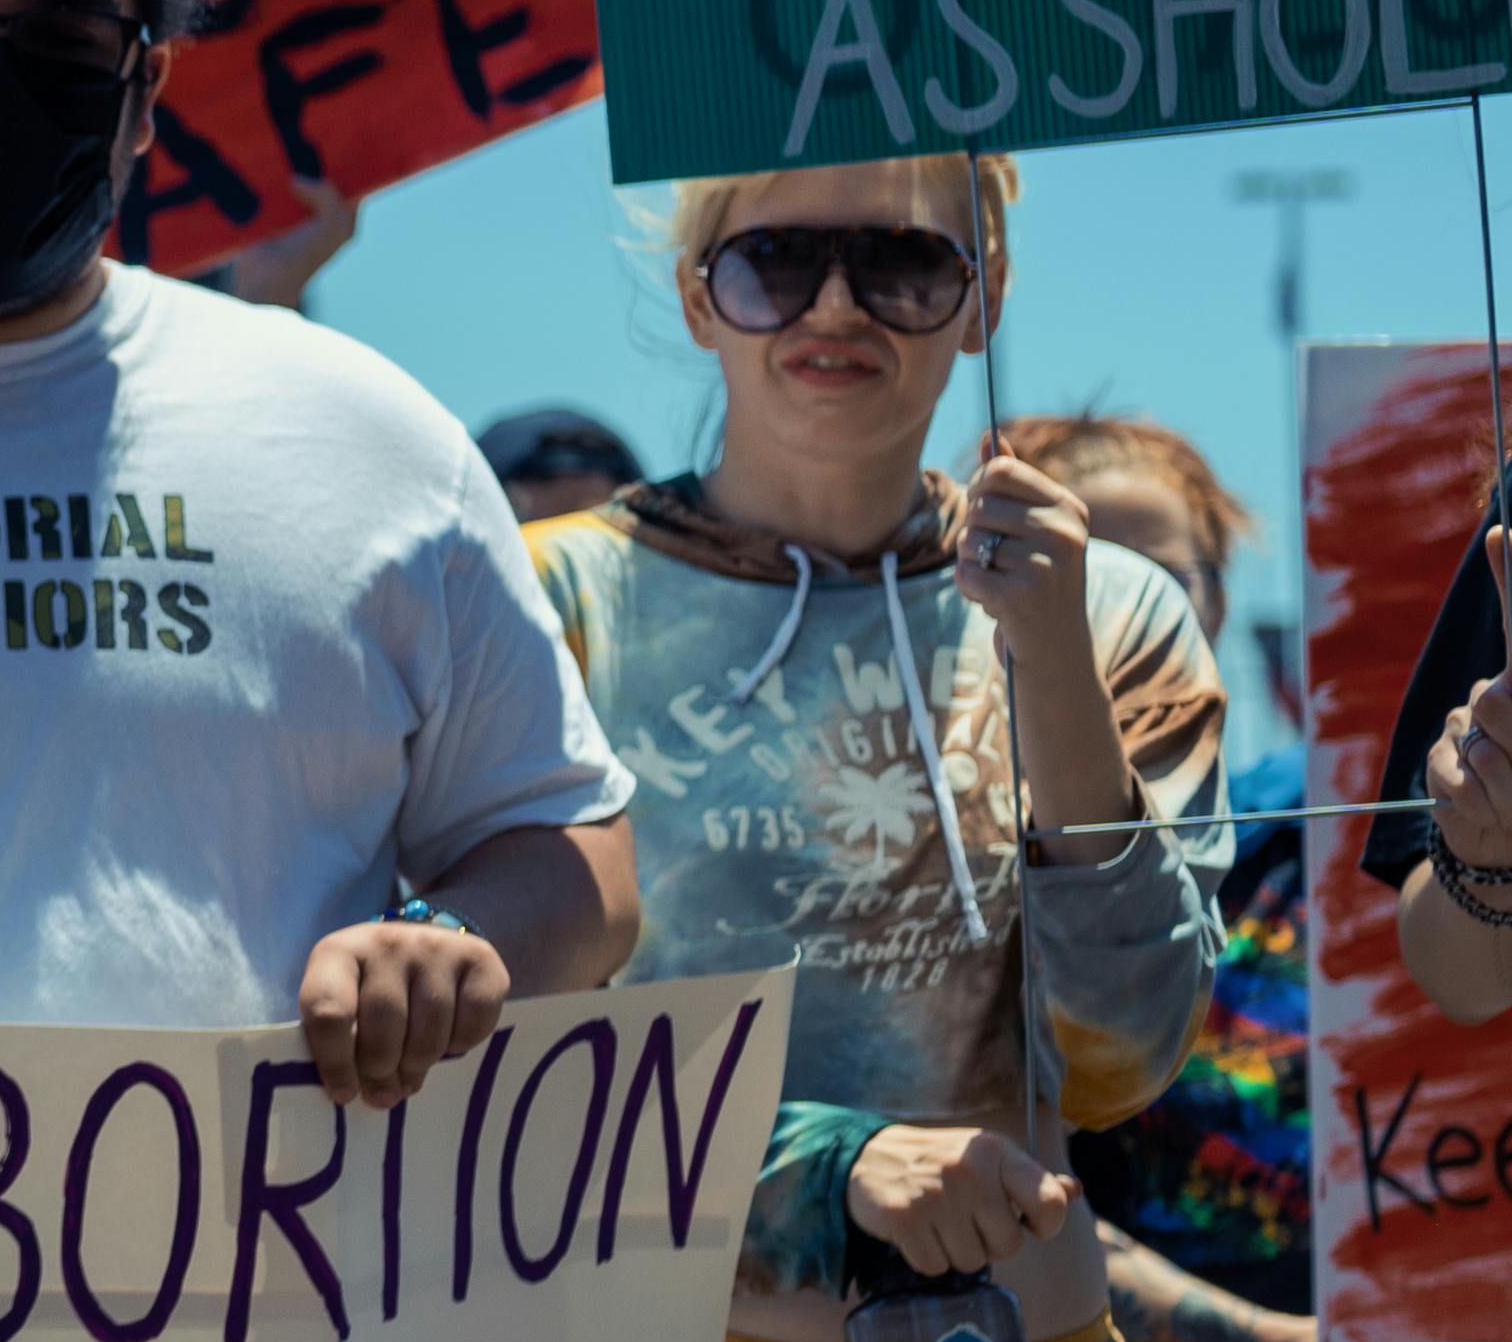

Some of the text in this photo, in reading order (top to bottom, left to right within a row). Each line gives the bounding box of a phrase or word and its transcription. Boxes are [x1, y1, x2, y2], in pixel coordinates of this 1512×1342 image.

[618, 642, 1013, 799] KEY WE
[702, 804, 807, 852] 6735
